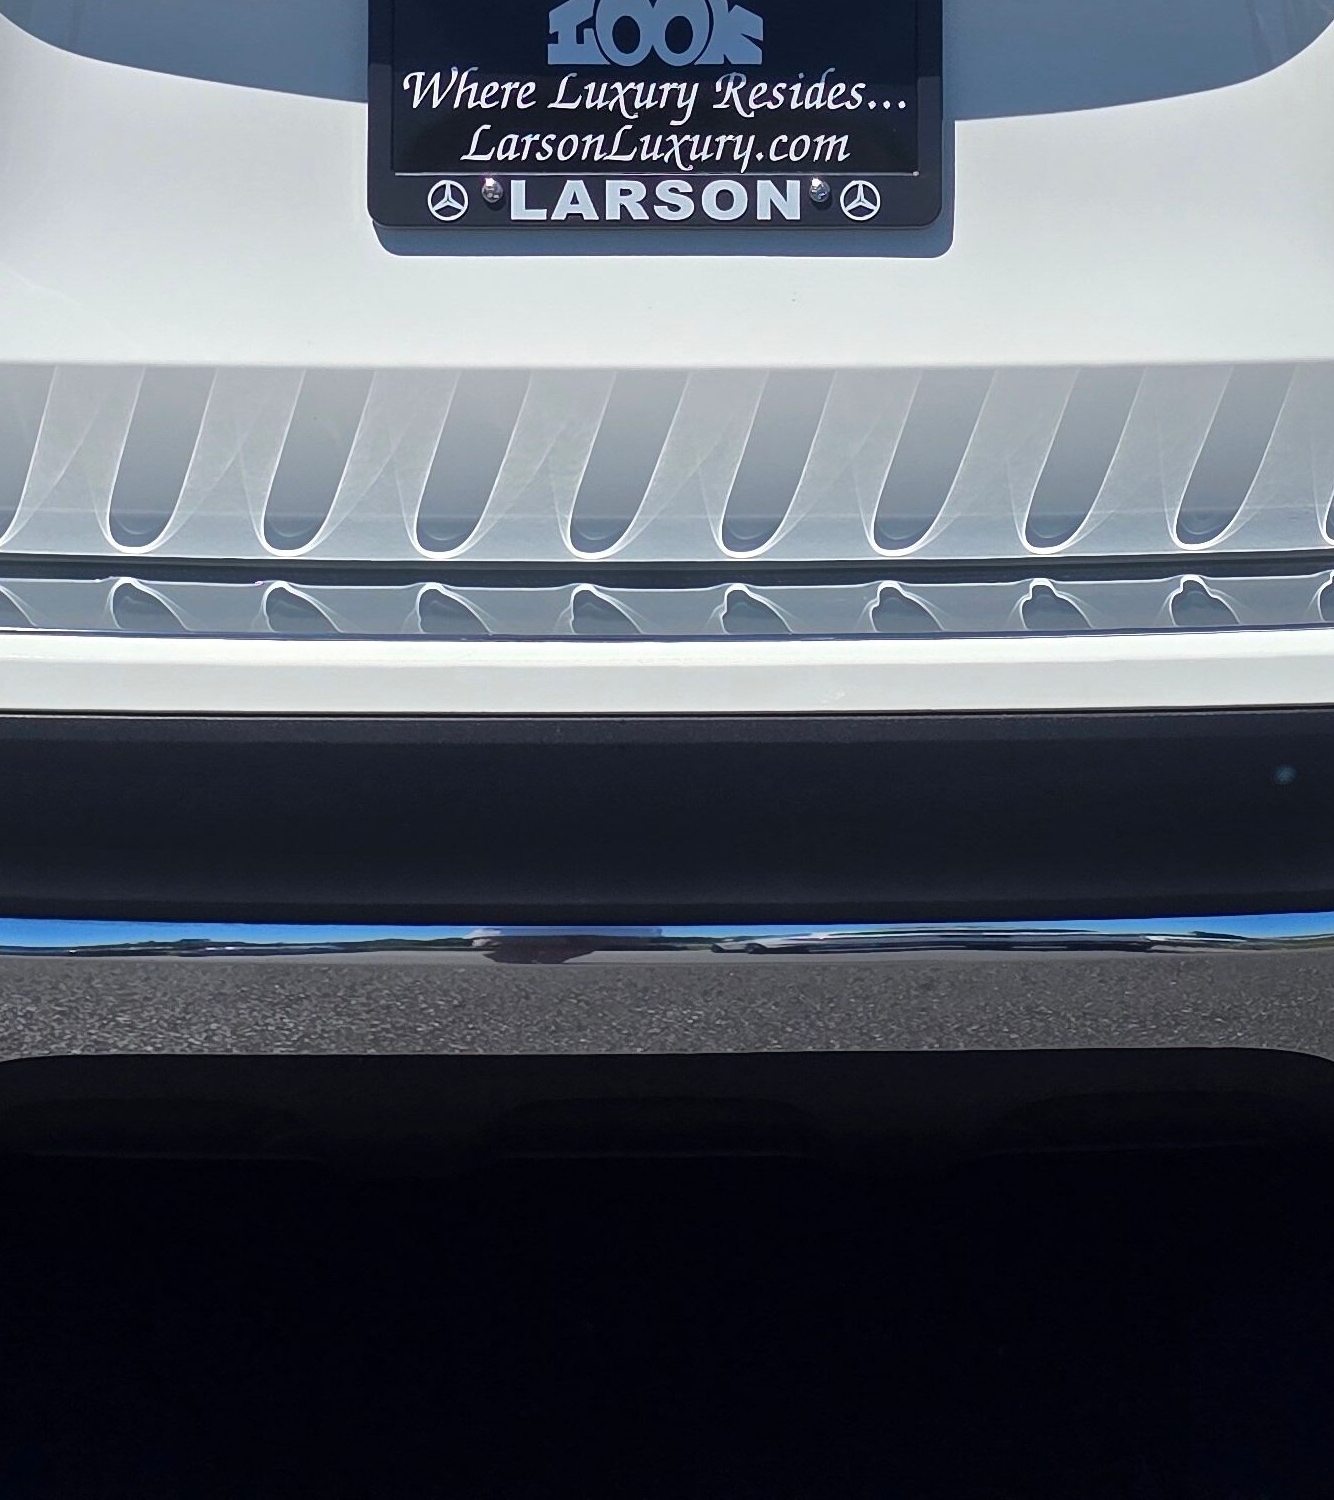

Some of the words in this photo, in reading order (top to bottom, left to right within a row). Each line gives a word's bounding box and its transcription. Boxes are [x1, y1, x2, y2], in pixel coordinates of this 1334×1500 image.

[402, 66, 537, 110] Where
[547, 72, 699, 126] Luxury
[712, 67, 907, 118] Resides...
[460, 124, 851, 174] LarsonLuxury.com
[510, 179, 801, 221] LARSON
